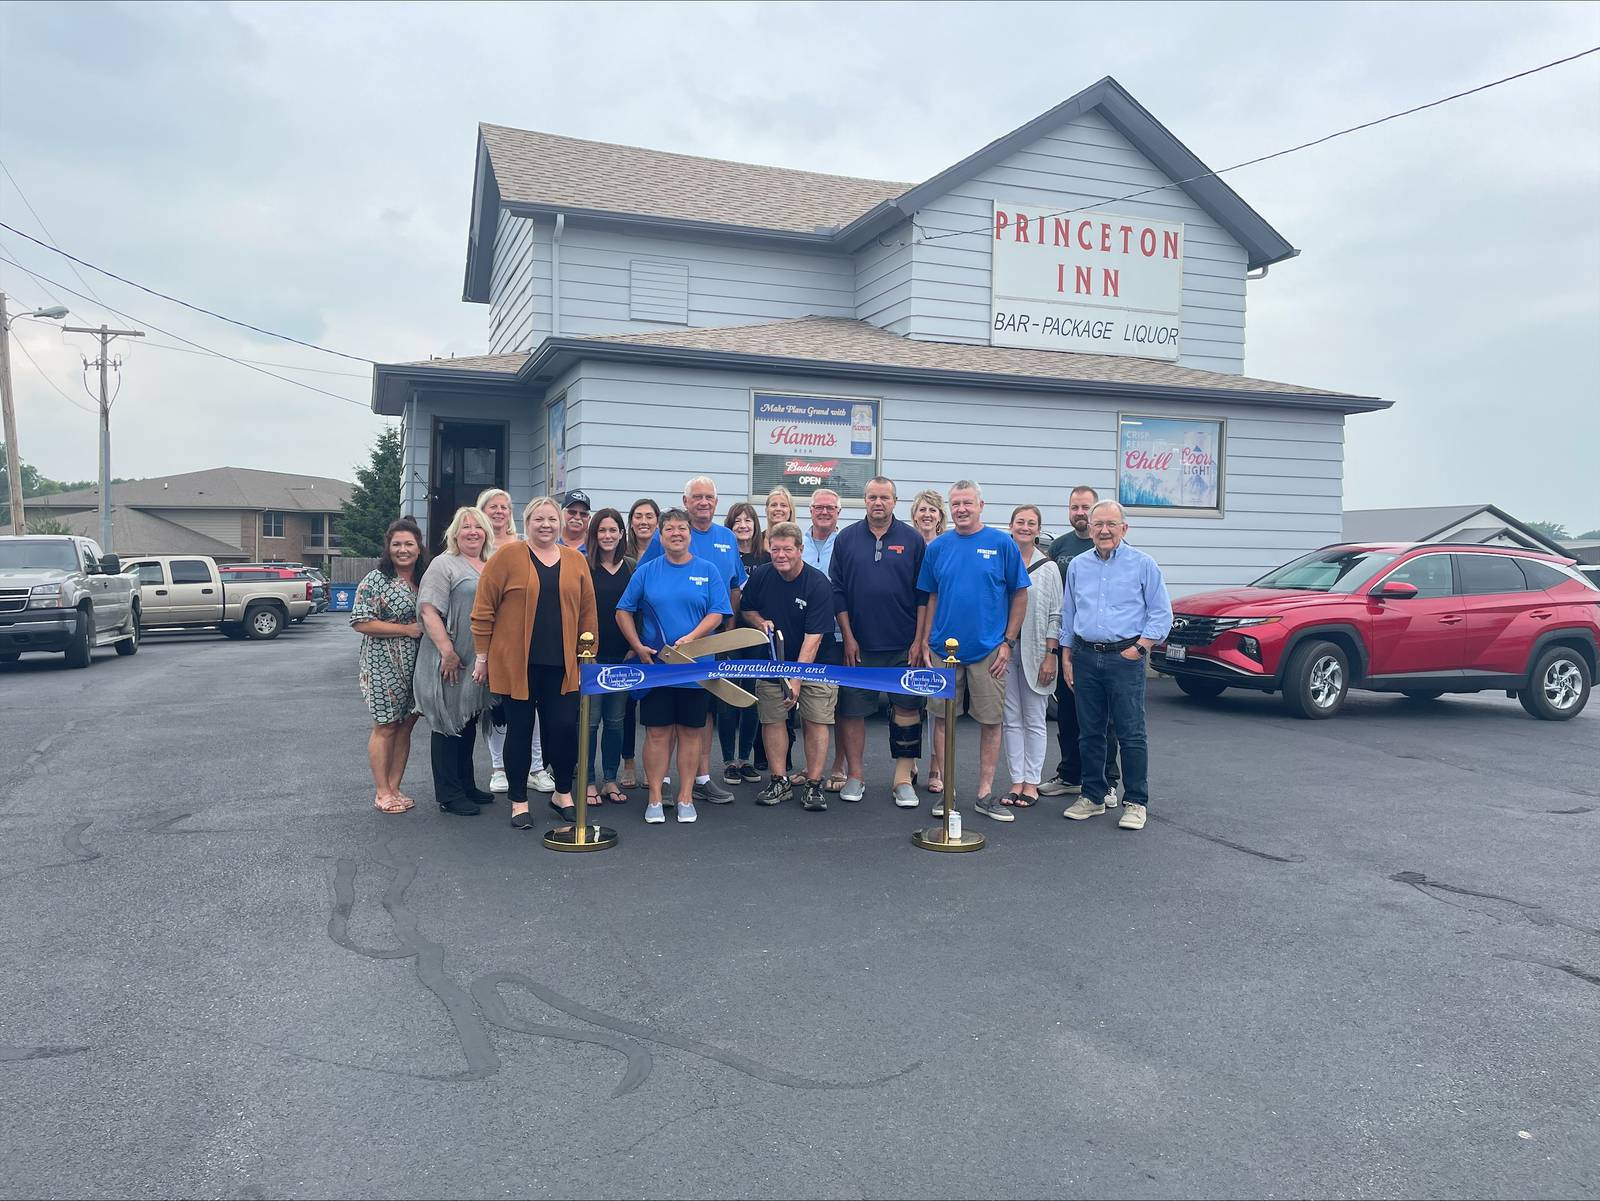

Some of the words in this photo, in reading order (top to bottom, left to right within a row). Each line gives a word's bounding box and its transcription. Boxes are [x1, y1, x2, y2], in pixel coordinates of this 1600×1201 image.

[995, 210, 1179, 260] PRINCETON
[1057, 263, 1120, 298] INN
[1123, 323, 1179, 346] LIQUOR
[760, 403, 785, 413] Make
[786, 405, 806, 414] Plans
[830, 408, 847, 417] with
[769, 425, 838, 447] Hamm's
[785, 461, 833, 473] Budweiser
[1125, 450, 1173, 471] Chill
[798, 476, 821, 485] OPEN
[718, 662, 802, 673] Congratulations
[805, 665, 827, 674] and
